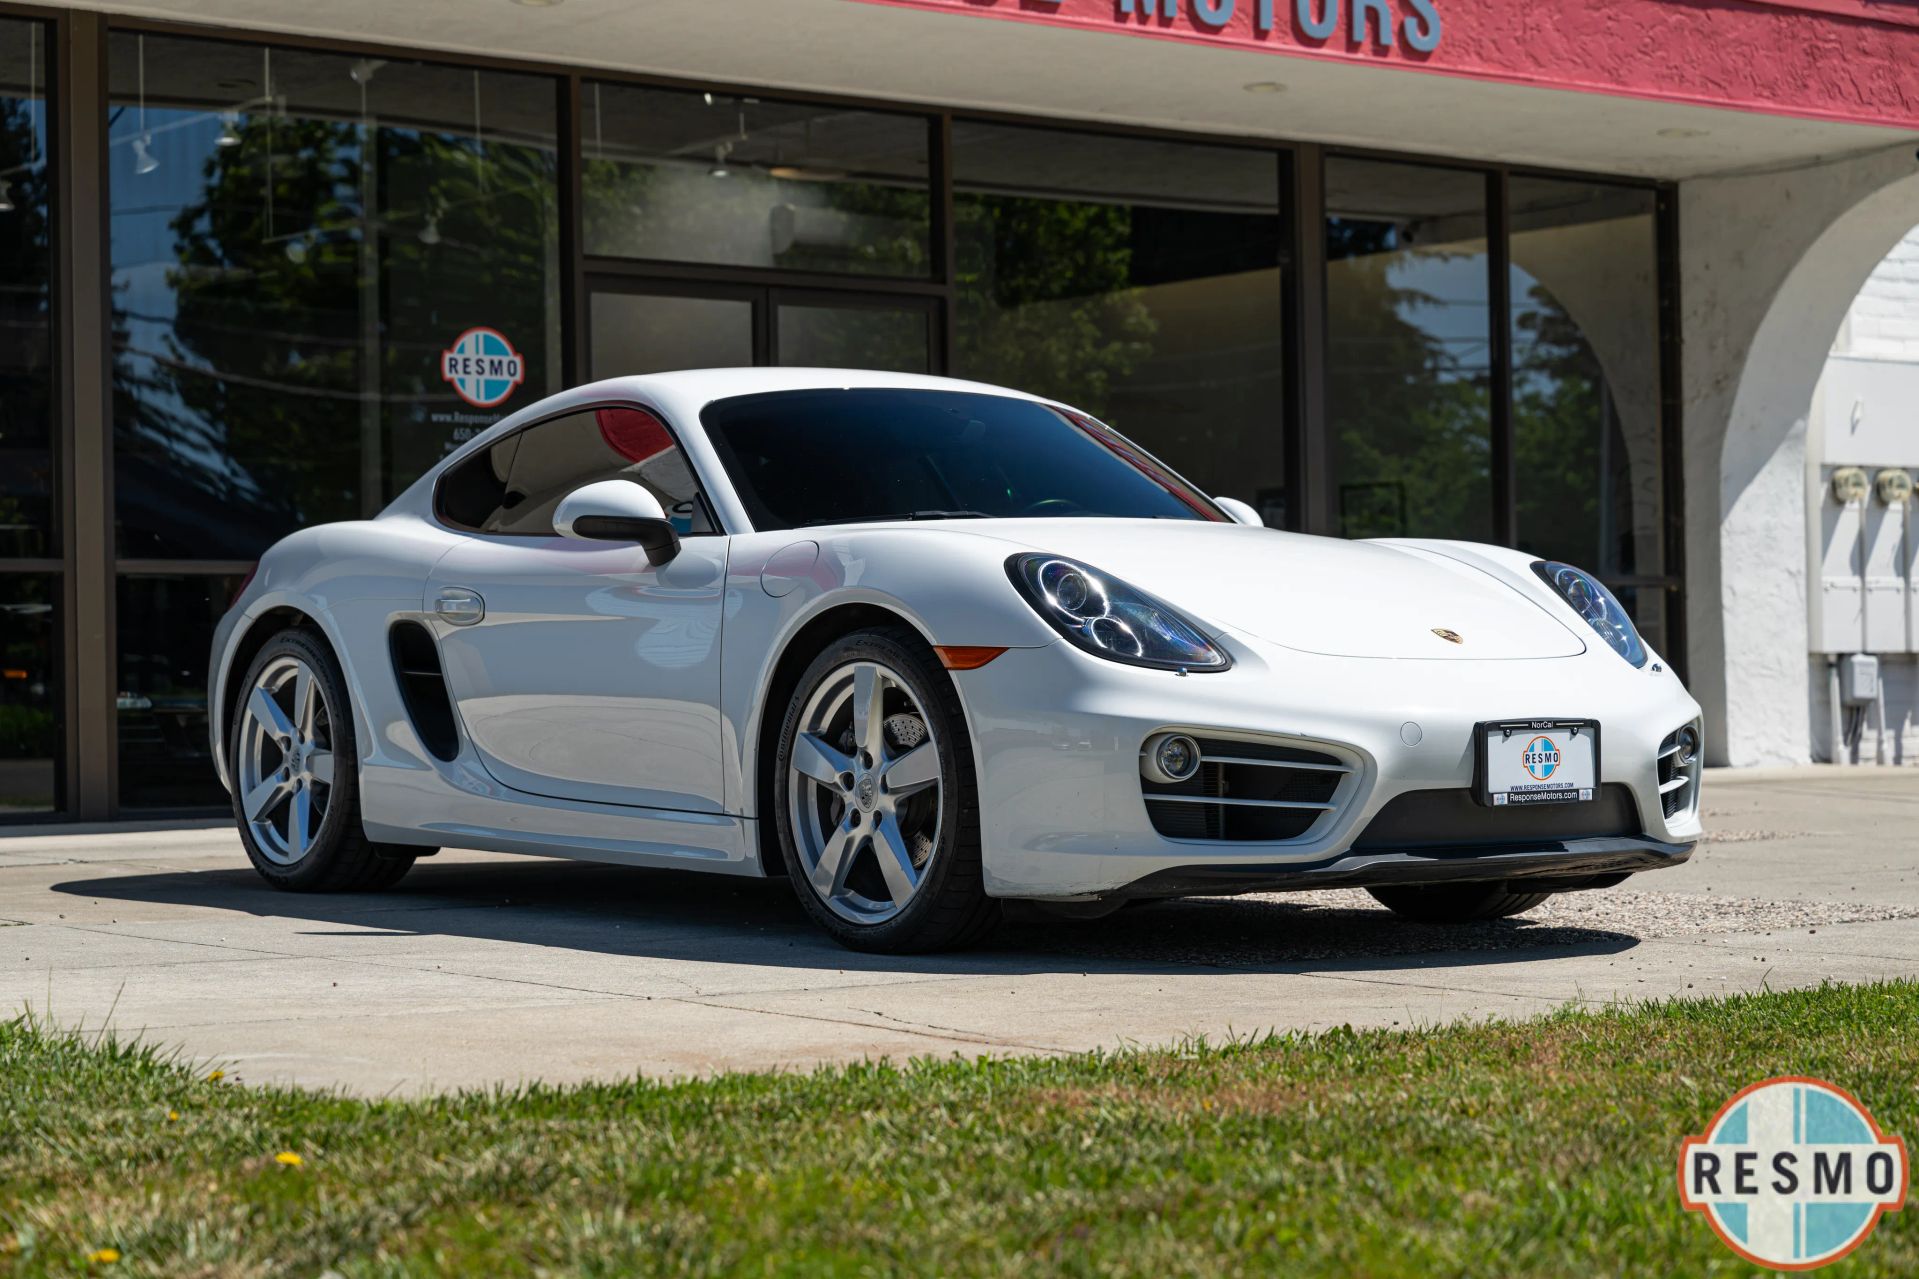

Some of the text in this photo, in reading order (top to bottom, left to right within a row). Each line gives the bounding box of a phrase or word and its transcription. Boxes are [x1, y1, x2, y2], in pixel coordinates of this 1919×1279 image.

[1118, 0, 1441, 52] ORS
[448, 357, 518, 377] RESMO
[1531, 721, 1554, 729] NorCal
[1525, 752, 1559, 764] RESMO
[1510, 782, 1574, 792] WWW.RESPONSEMOTORS.COM
[1510, 792, 1578, 802] ResponseMotors.com
